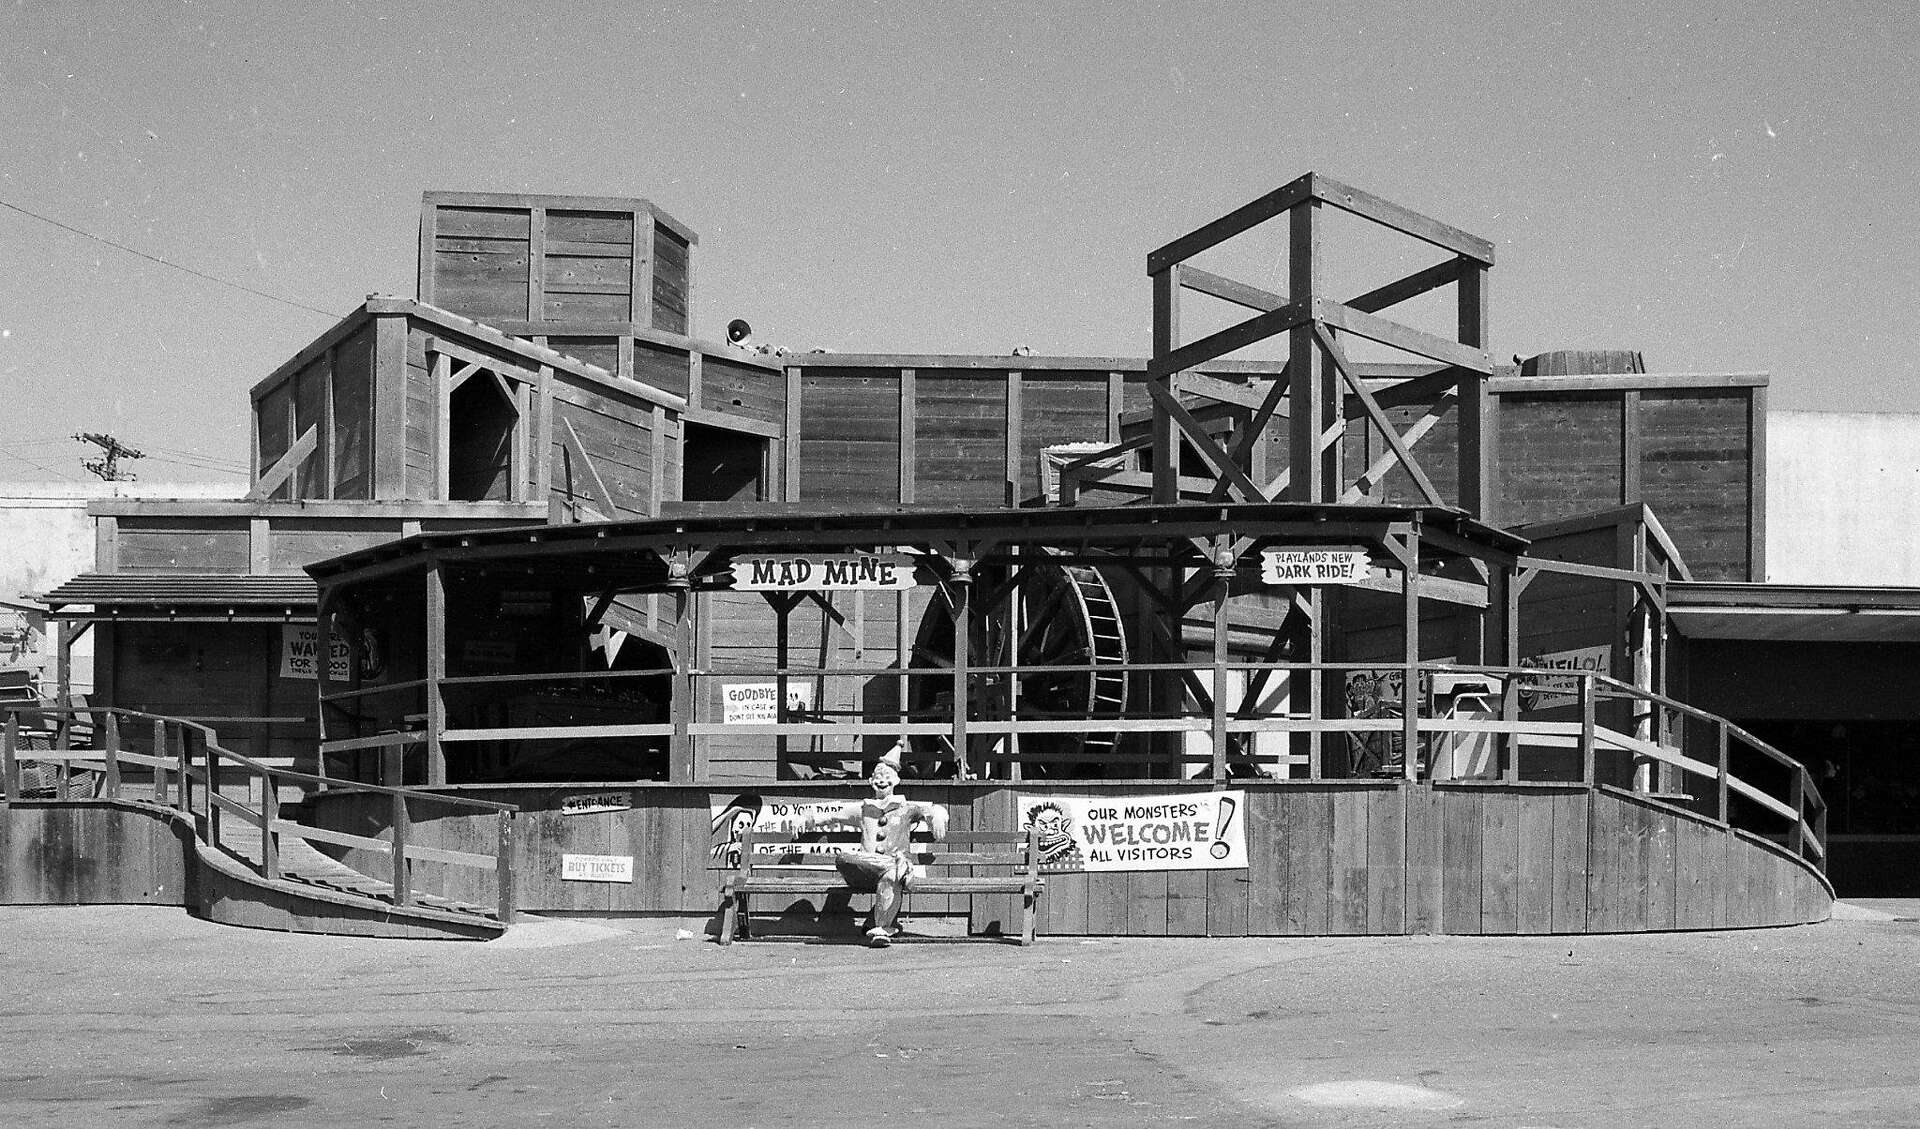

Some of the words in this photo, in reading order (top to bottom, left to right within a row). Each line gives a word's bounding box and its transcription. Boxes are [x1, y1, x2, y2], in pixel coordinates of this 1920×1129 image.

[1332, 553, 1353, 563] NEW
[751, 558, 811, 586] MAD
[822, 556, 897, 586] MINE
[1275, 564, 1312, 579] DARK
[1316, 563, 1355, 579] RIDE!
[290, 641, 349, 658] WAED
[289, 657, 311, 668] FOR
[728, 687, 777, 702] GOODBYE
[576, 795, 624, 810] ENTRANCE
[770, 803, 788, 816] DO
[1088, 805, 1118, 820] OUR
[1124, 803, 1197, 819] MONSTERS
[1081, 821, 1210, 846] WELCOME
[1089, 849, 1112, 863] ALL
[1118, 847, 1193, 861] VISITORS
[568, 861, 588, 873] BUY
[590, 862, 626, 873] TICKETS
